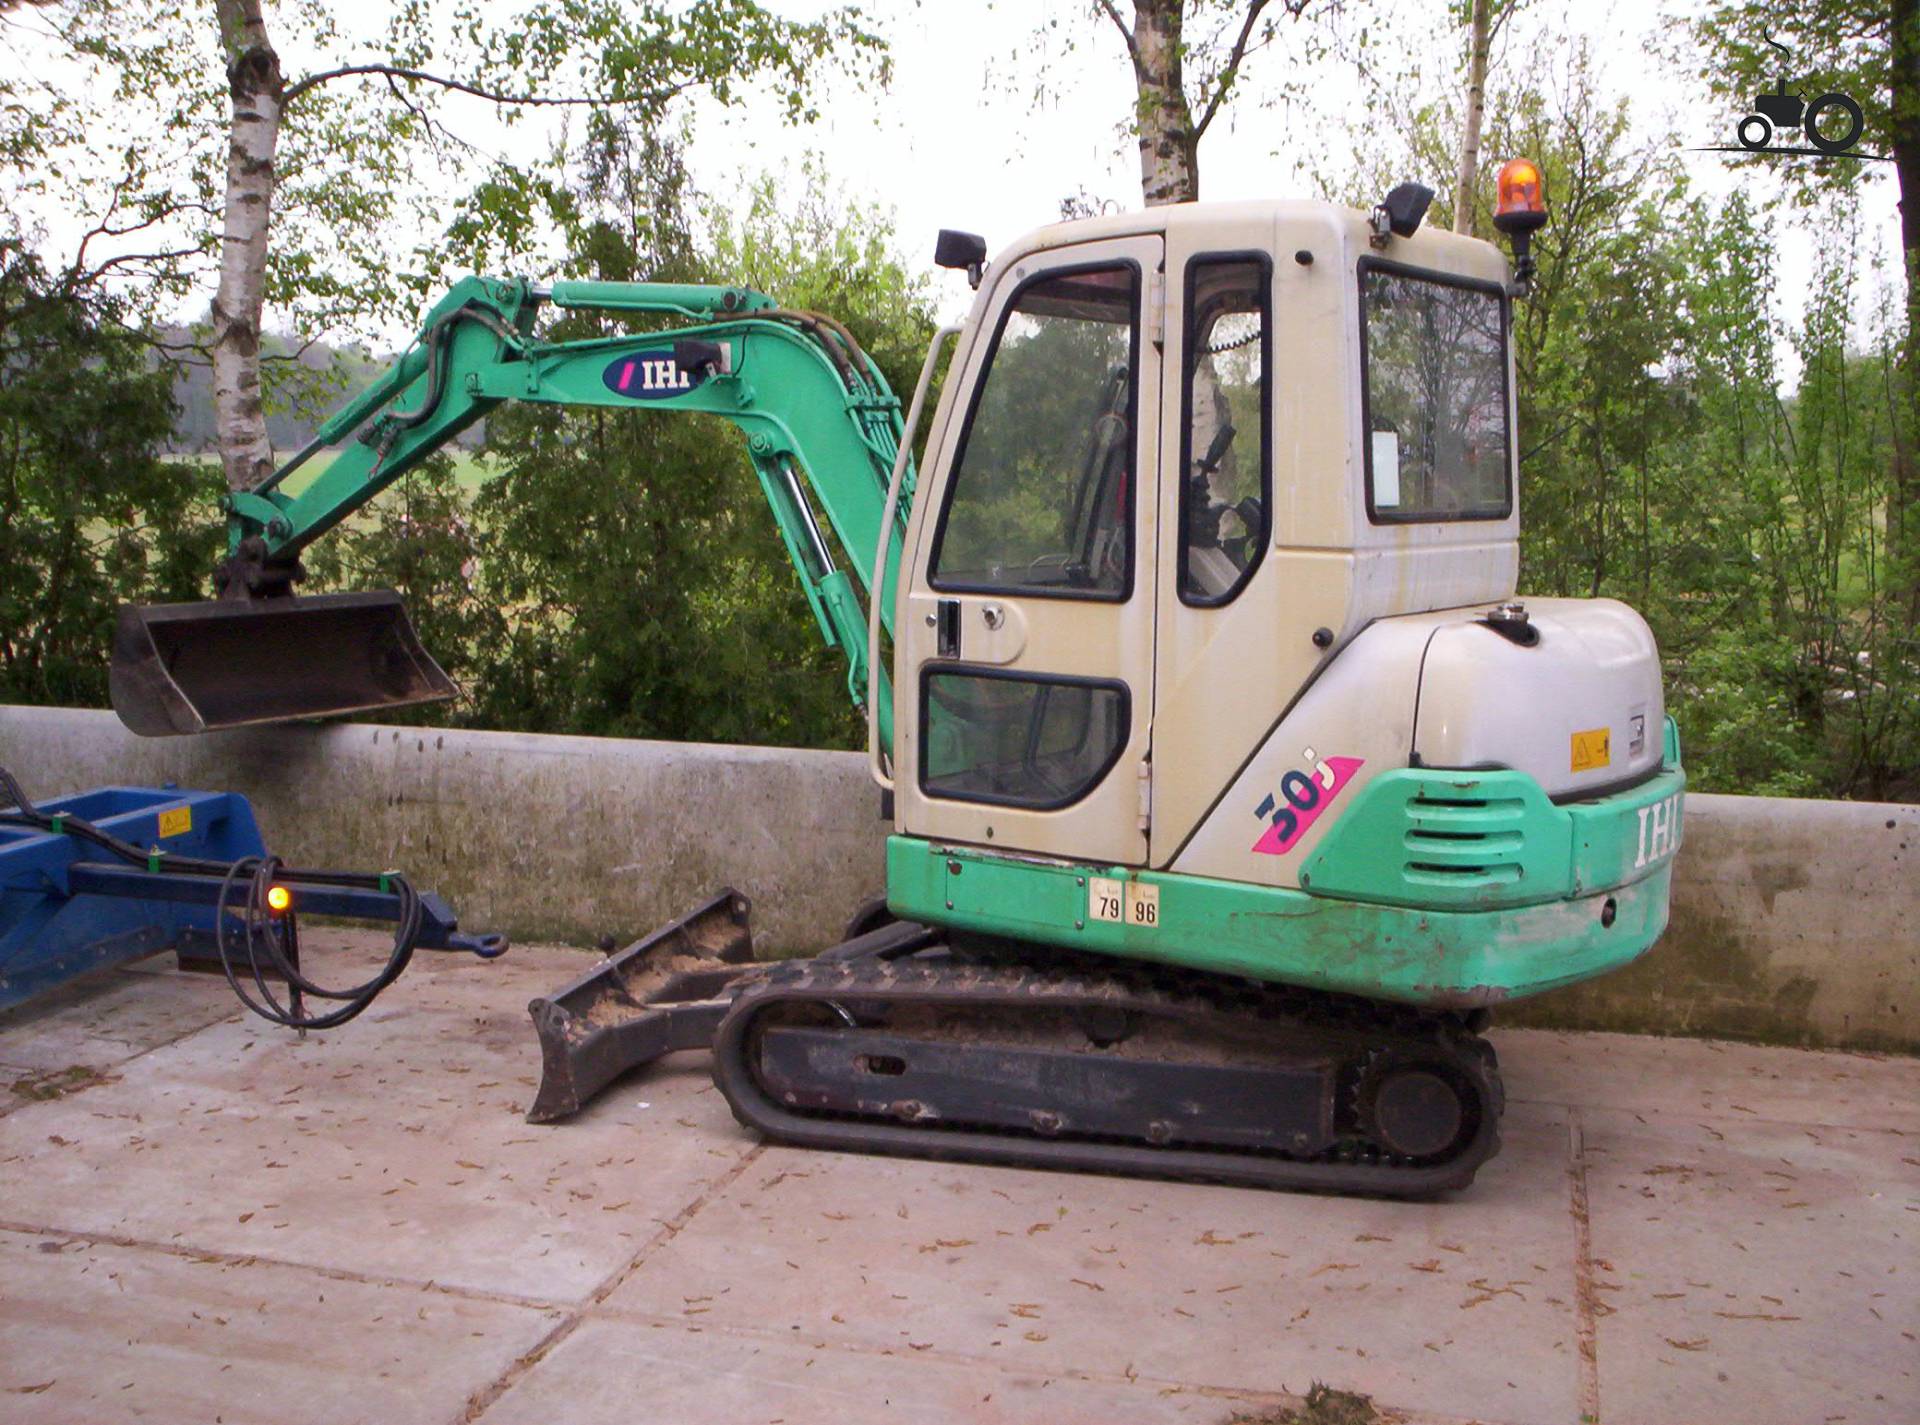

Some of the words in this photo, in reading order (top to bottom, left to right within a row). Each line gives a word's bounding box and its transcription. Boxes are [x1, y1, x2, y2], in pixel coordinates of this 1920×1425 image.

[1634, 794, 1679, 868] IHI
[1100, 896, 1119, 919] 79
[1135, 901, 1156, 924] 96
